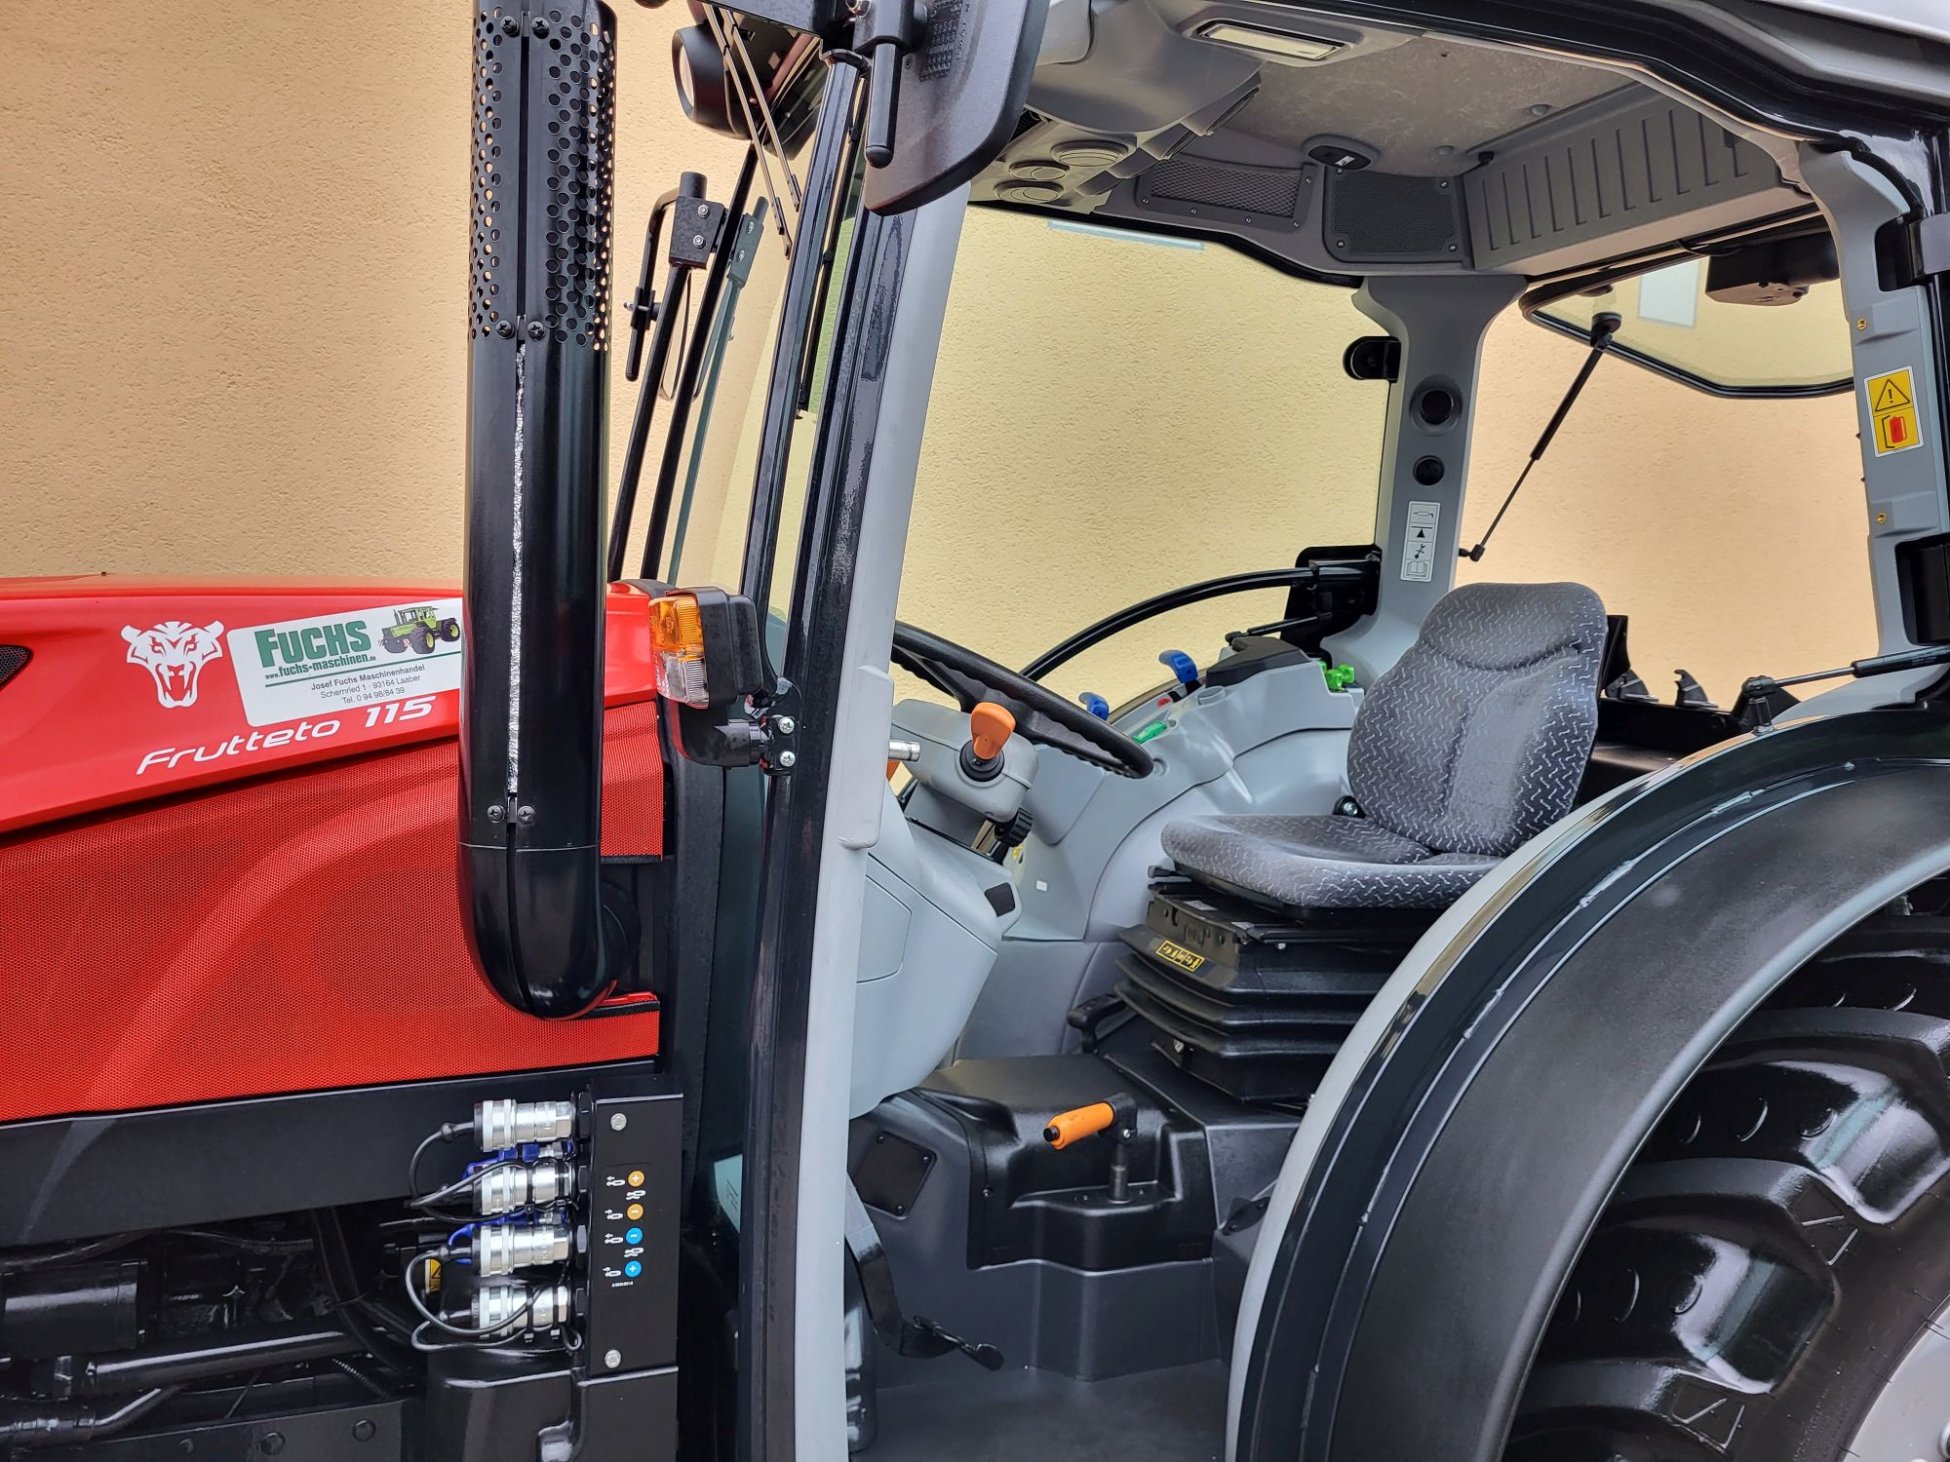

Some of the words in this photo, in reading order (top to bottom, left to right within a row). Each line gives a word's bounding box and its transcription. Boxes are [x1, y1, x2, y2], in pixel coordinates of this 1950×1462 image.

[254, 620, 371, 669] FUCHS
[311, 681, 333, 691] Josef
[334, 678, 359, 687] Fuchs
[359, 664, 425, 682] Maschinenhandel
[373, 678, 395, 689] 93164
[396, 674, 421, 685] Laaber
[342, 697, 355, 705] Tel.
[396, 686, 405, 695] 39
[136, 719, 341, 776] Frutteto
[364, 695, 437, 728] 115
